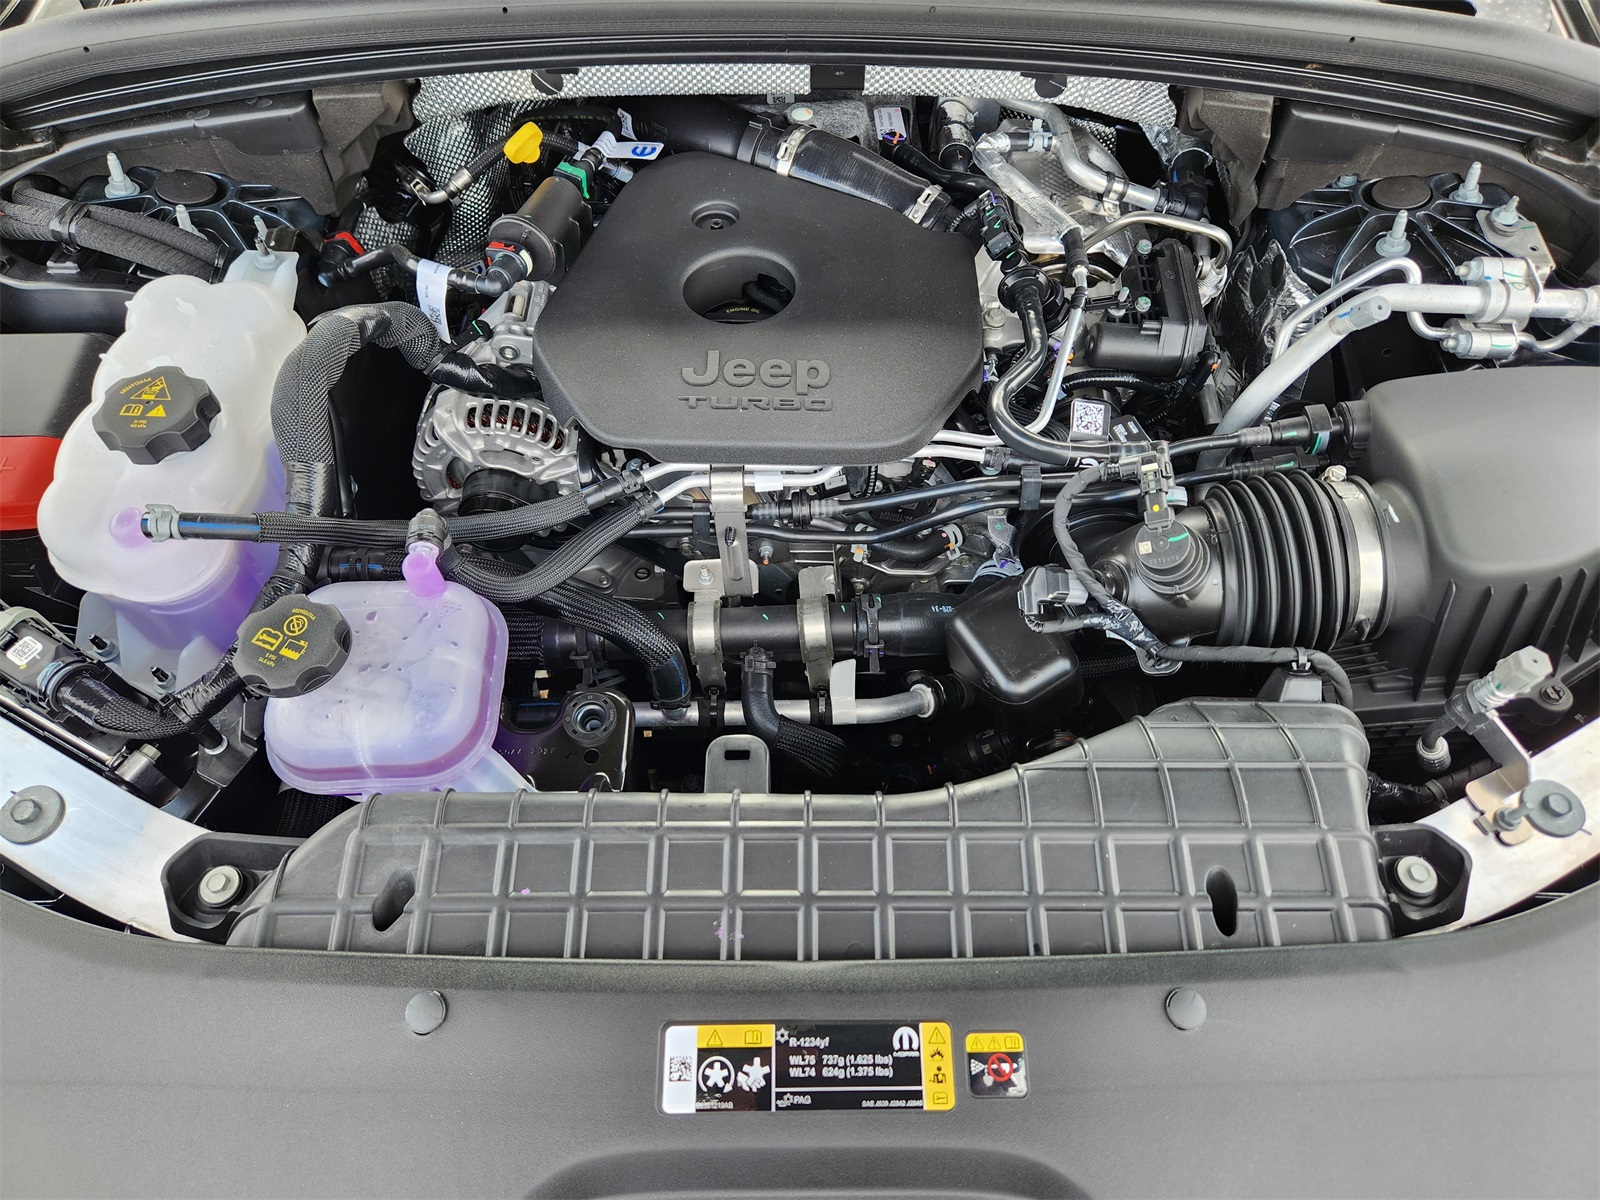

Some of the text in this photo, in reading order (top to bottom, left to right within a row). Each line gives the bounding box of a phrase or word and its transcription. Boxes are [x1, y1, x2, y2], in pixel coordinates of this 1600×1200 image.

[681, 350, 831, 396] Jeep
[678, 395, 833, 411] TURBO
[267, 659, 276, 667] kPa
[788, 1037, 830, 1049] R-1234yf
[788, 1054, 893, 1067] WL75 737g (1.625 lbs)
[788, 1066, 894, 1079] WL74 624g (1.375 lbs)
[793, 1095, 811, 1105] PAG
